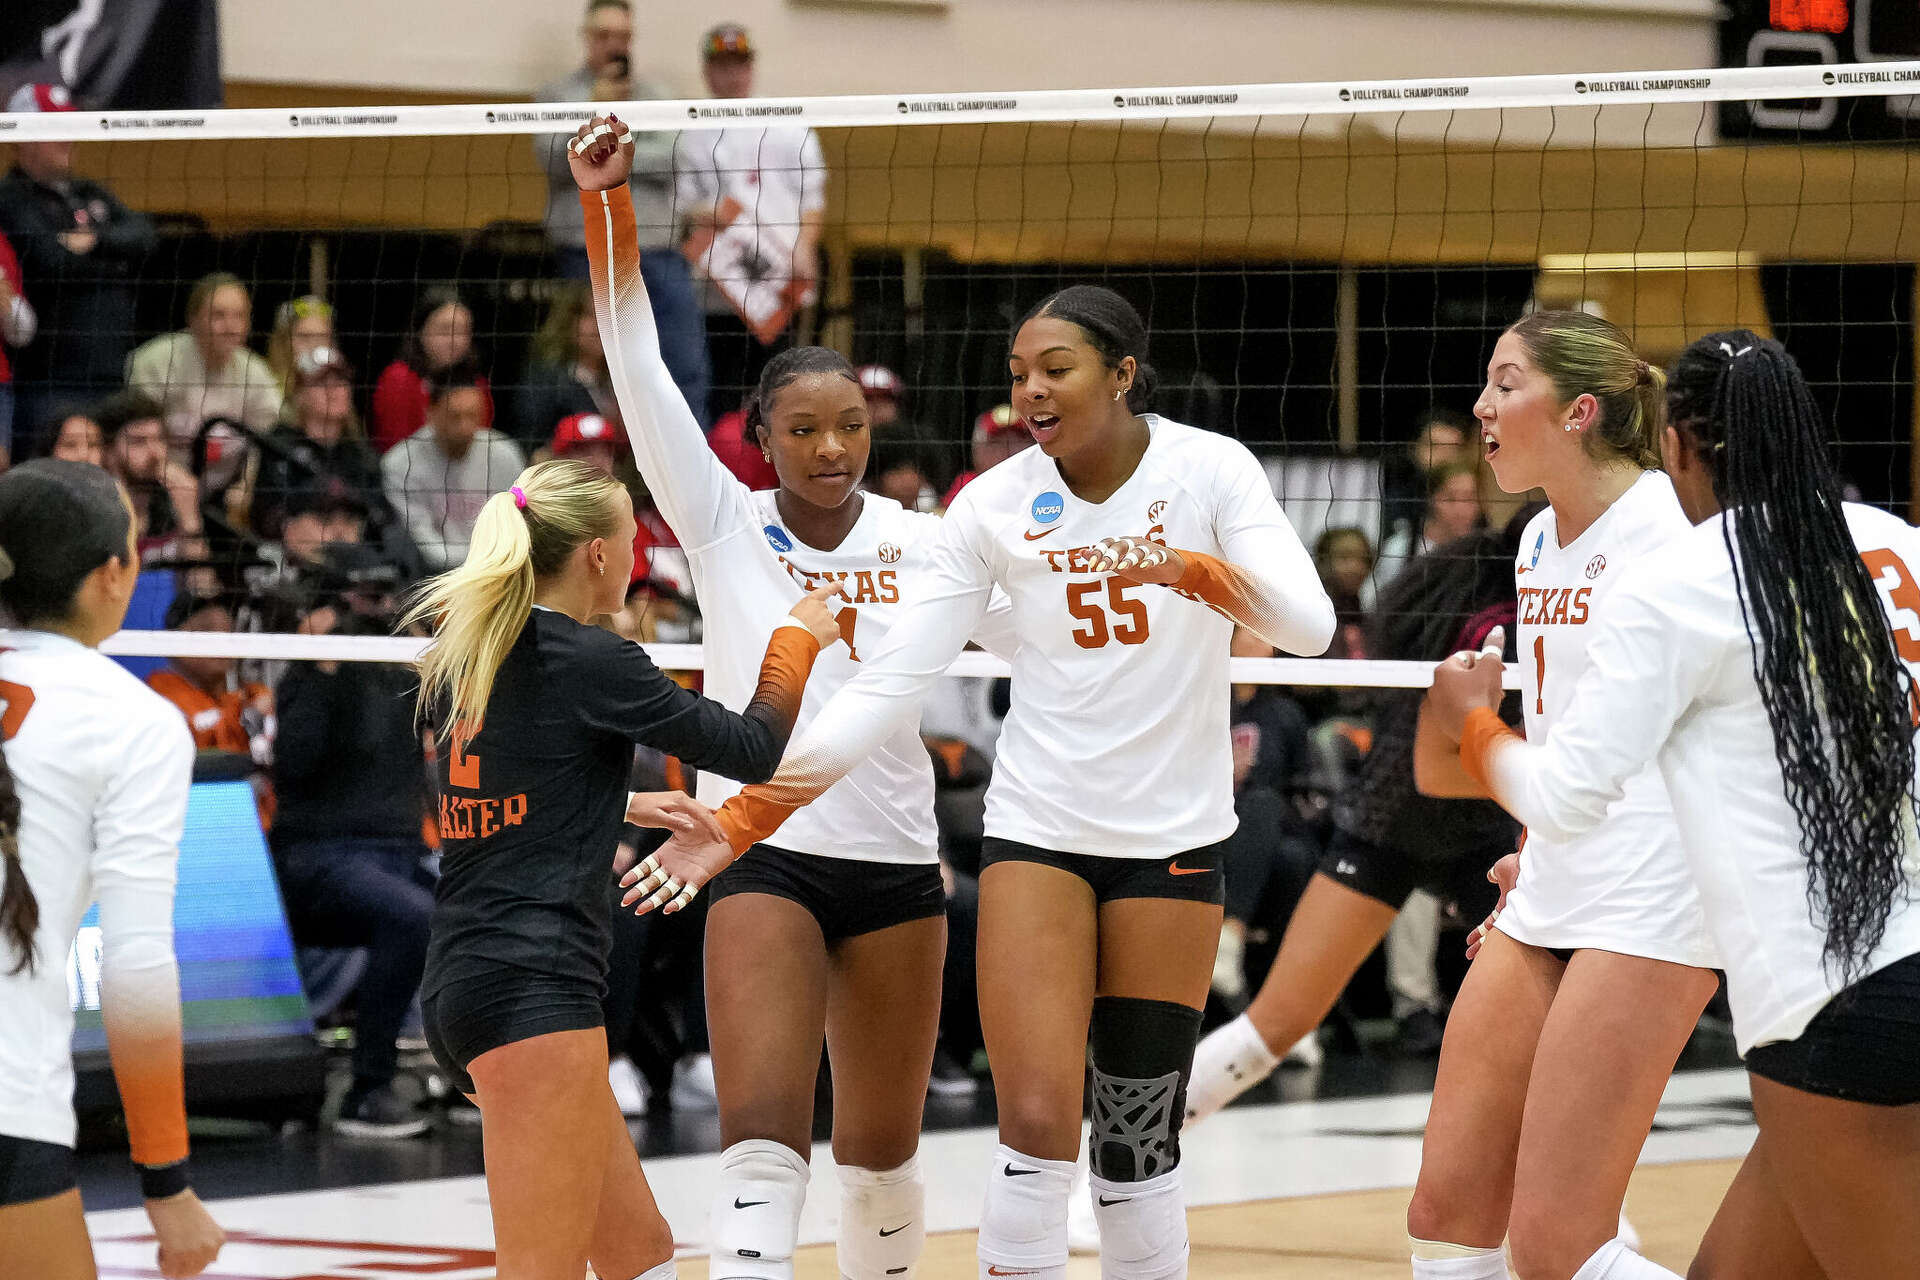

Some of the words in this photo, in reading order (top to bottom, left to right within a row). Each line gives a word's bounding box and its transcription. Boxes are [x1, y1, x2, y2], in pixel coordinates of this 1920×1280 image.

[1588, 80, 1641, 94] VOLLEYBALL
[1642, 77, 1711, 92] CHAMPIONSHIP
[1837, 71, 1891, 85] VOLLEYBALL
[1126, 95, 1174, 109] VOLLEYBALL
[1175, 93, 1239, 107] CHAMPIONSHIP
[1352, 88, 1402, 102] VOLLEYBALL
[1403, 86, 1470, 100] CHAMPIONSHIP
[699, 107, 744, 119] VOLLEYBALL
[745, 104, 804, 118] CHAMPIONSHIP
[909, 101, 956, 114] VOLLEYBALL
[957, 99, 1017, 112] CHAMPIONSHIP
[300, 115, 341, 127] VOLLEYBALL
[496, 112, 541, 123] VOLLEYBALL
[1035, 504, 1062, 516] NCAA
[878, 542, 902, 563] SEC
[1066, 575, 1150, 649] 55
[1518, 587, 1593, 625] TEXAS
[1533, 635, 1546, 715] 1
[438, 793, 528, 839] ALTER
